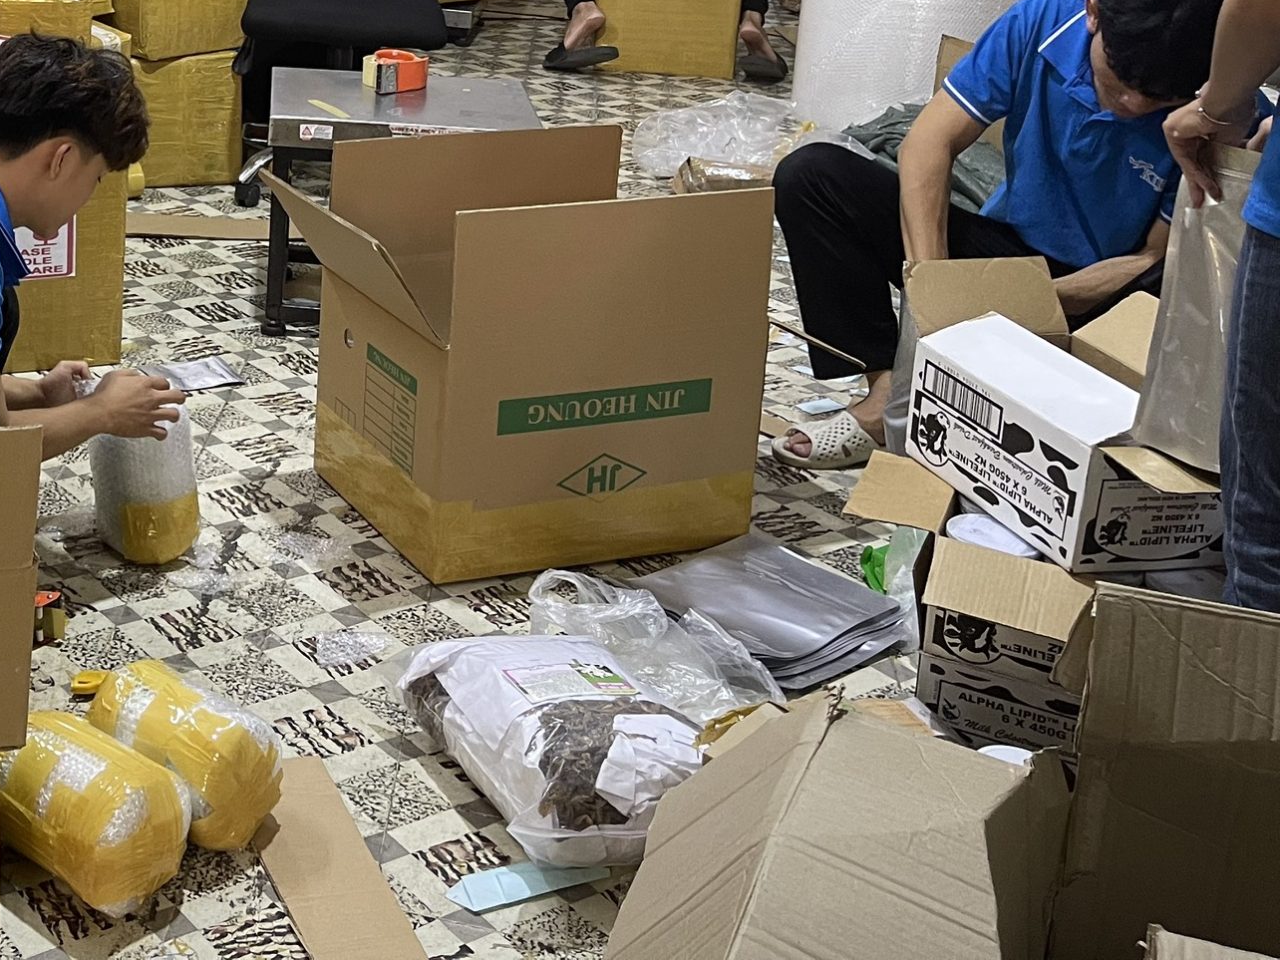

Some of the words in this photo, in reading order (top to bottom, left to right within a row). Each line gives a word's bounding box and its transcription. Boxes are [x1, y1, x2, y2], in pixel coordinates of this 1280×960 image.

[21, 247, 51, 256] ASE
[31, 265, 63, 274] ARE
[528, 393, 636, 426] HEOUNG
[645, 388, 685, 414] JIN
[974, 453, 989, 468] NZ
[586, 463, 622, 494] JH
[990, 462, 1012, 483] 450G
[1013, 480, 1020, 489] X
[1020, 486, 1027, 495] 6
[1024, 500, 1053, 524] ALPHA
[1174, 534, 1213, 544] ALPHA
[959, 692, 1005, 712] ALPHA
[1001, 714, 1010, 723] 6
[1015, 718, 1024, 728] X
[1029, 723, 1067, 740] 450G
